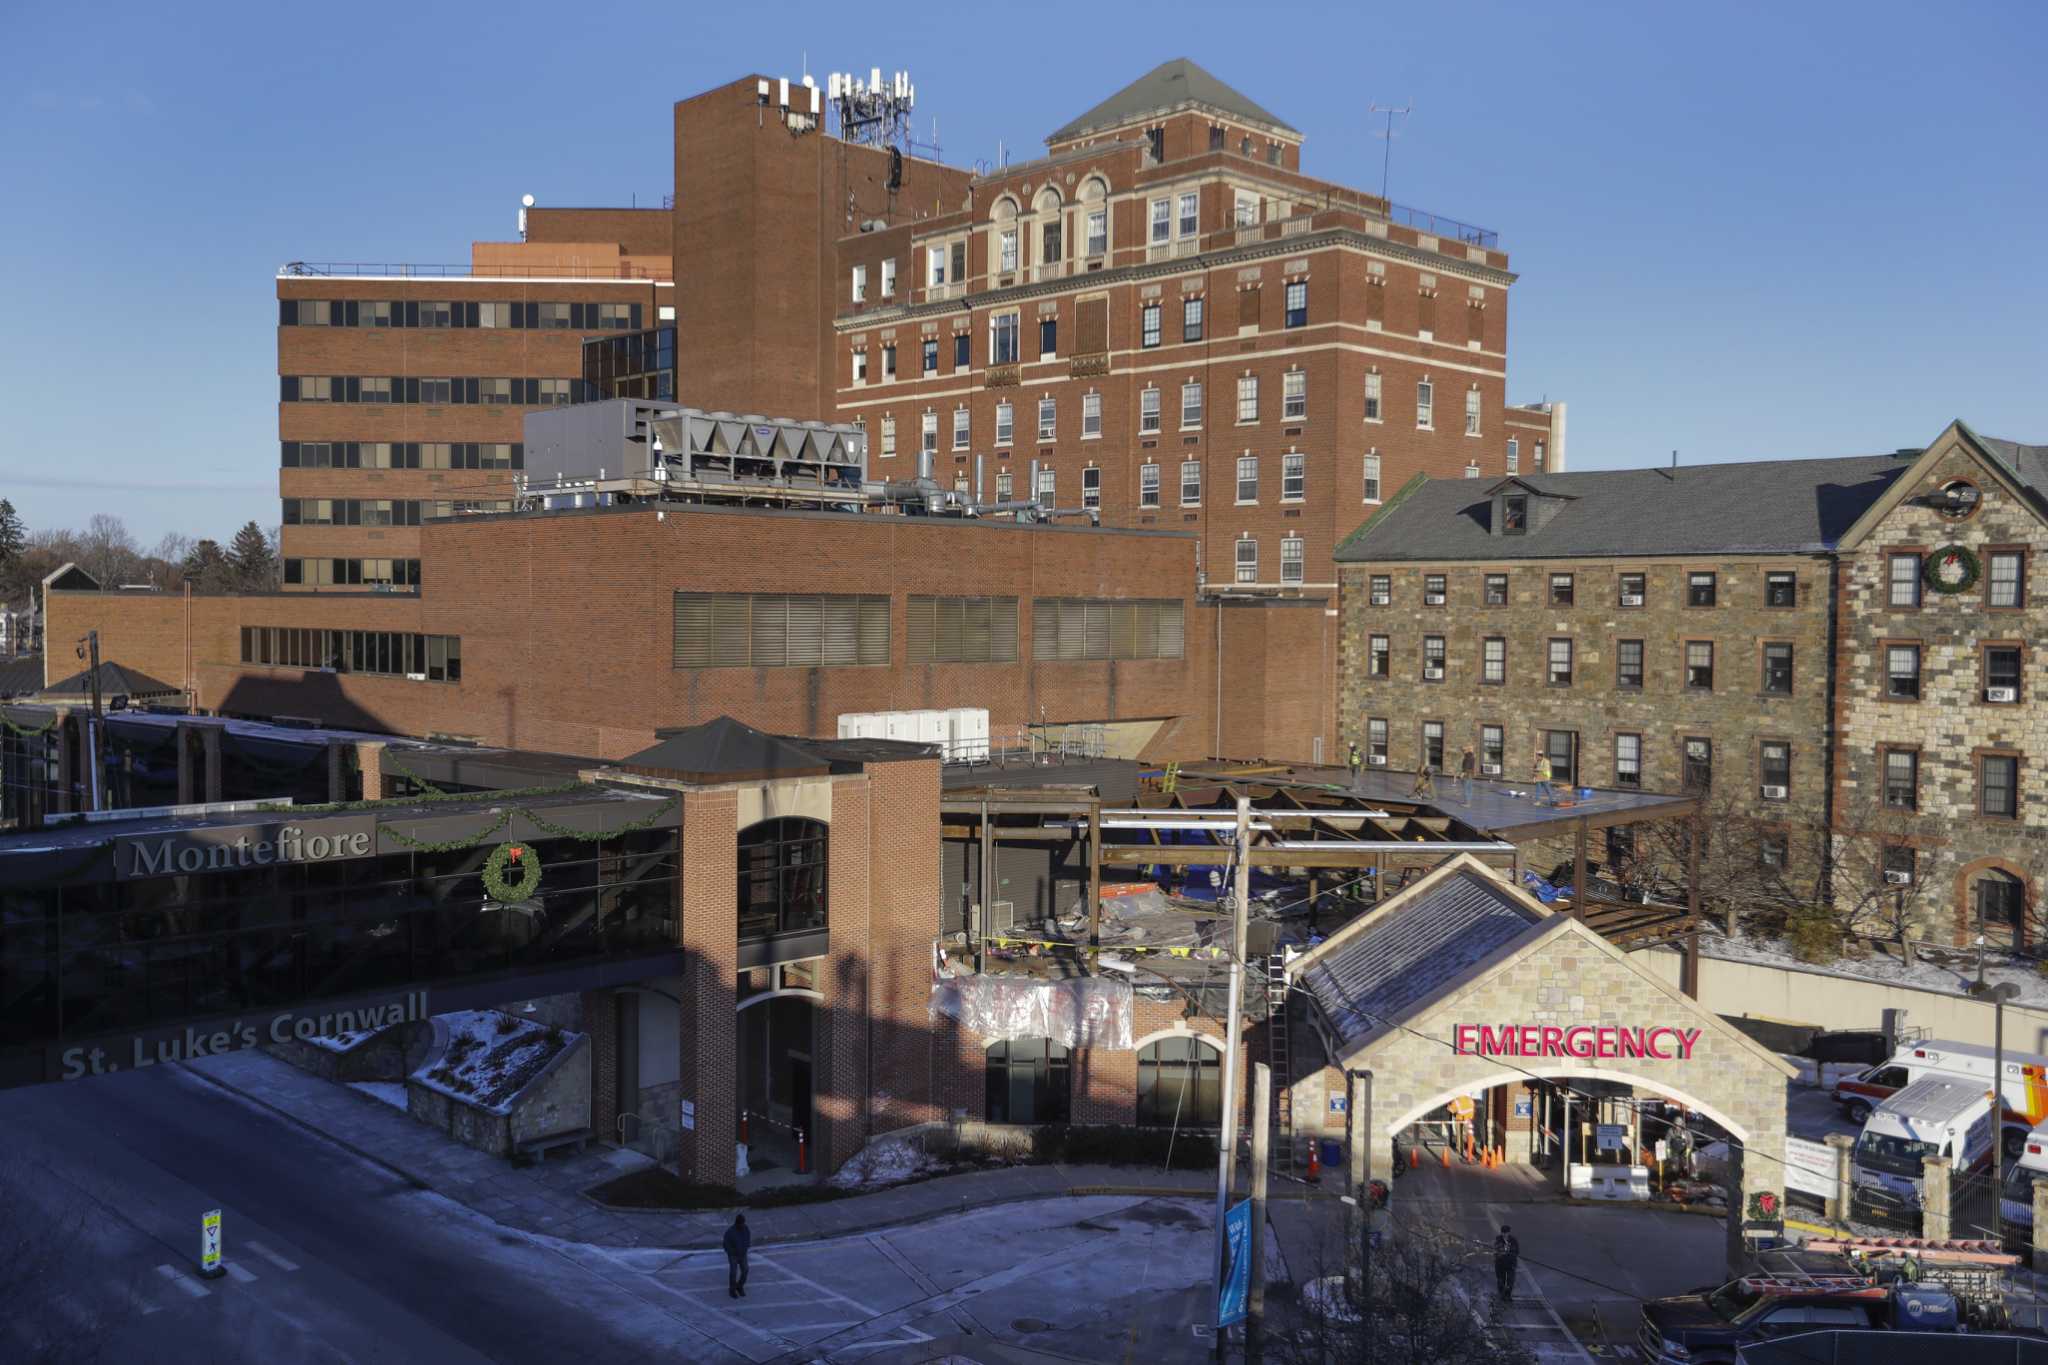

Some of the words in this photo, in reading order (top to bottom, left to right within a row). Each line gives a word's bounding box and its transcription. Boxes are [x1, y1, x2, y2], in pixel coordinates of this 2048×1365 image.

[129, 826, 371, 877] Montefiore
[62, 1047, 118, 1080] St.
[134, 1021, 257, 1067] Luke's
[270, 991, 427, 1044] Cornwall
[1453, 1023, 1702, 1060] EMERGENCY
